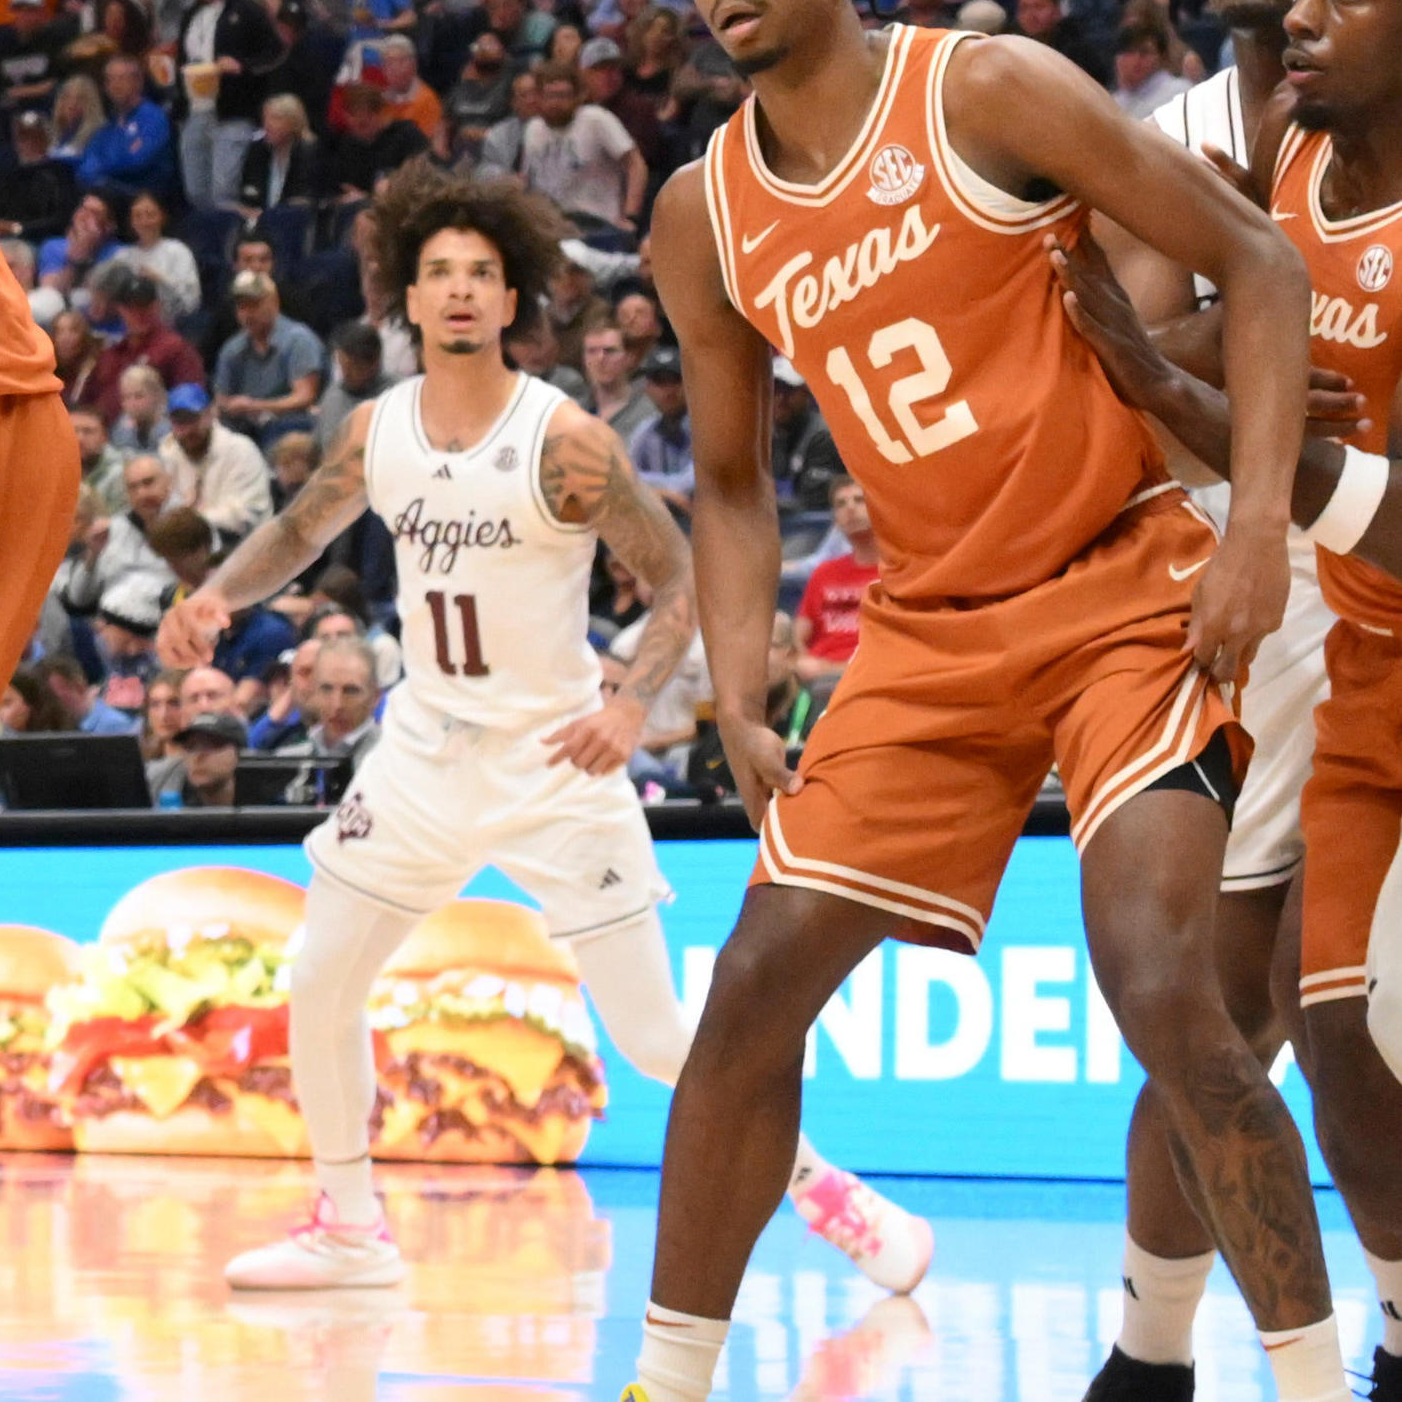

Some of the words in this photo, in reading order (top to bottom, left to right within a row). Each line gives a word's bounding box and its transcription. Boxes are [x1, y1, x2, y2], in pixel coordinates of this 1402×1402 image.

[873, 148, 913, 191] SEC
[754, 204, 941, 360] Texas
[1358, 247, 1391, 290] SEC
[1309, 290, 1388, 349] xas
[826, 317, 979, 465] 12
[394, 498, 522, 575] Aggies
[425, 590, 491, 677] 11
